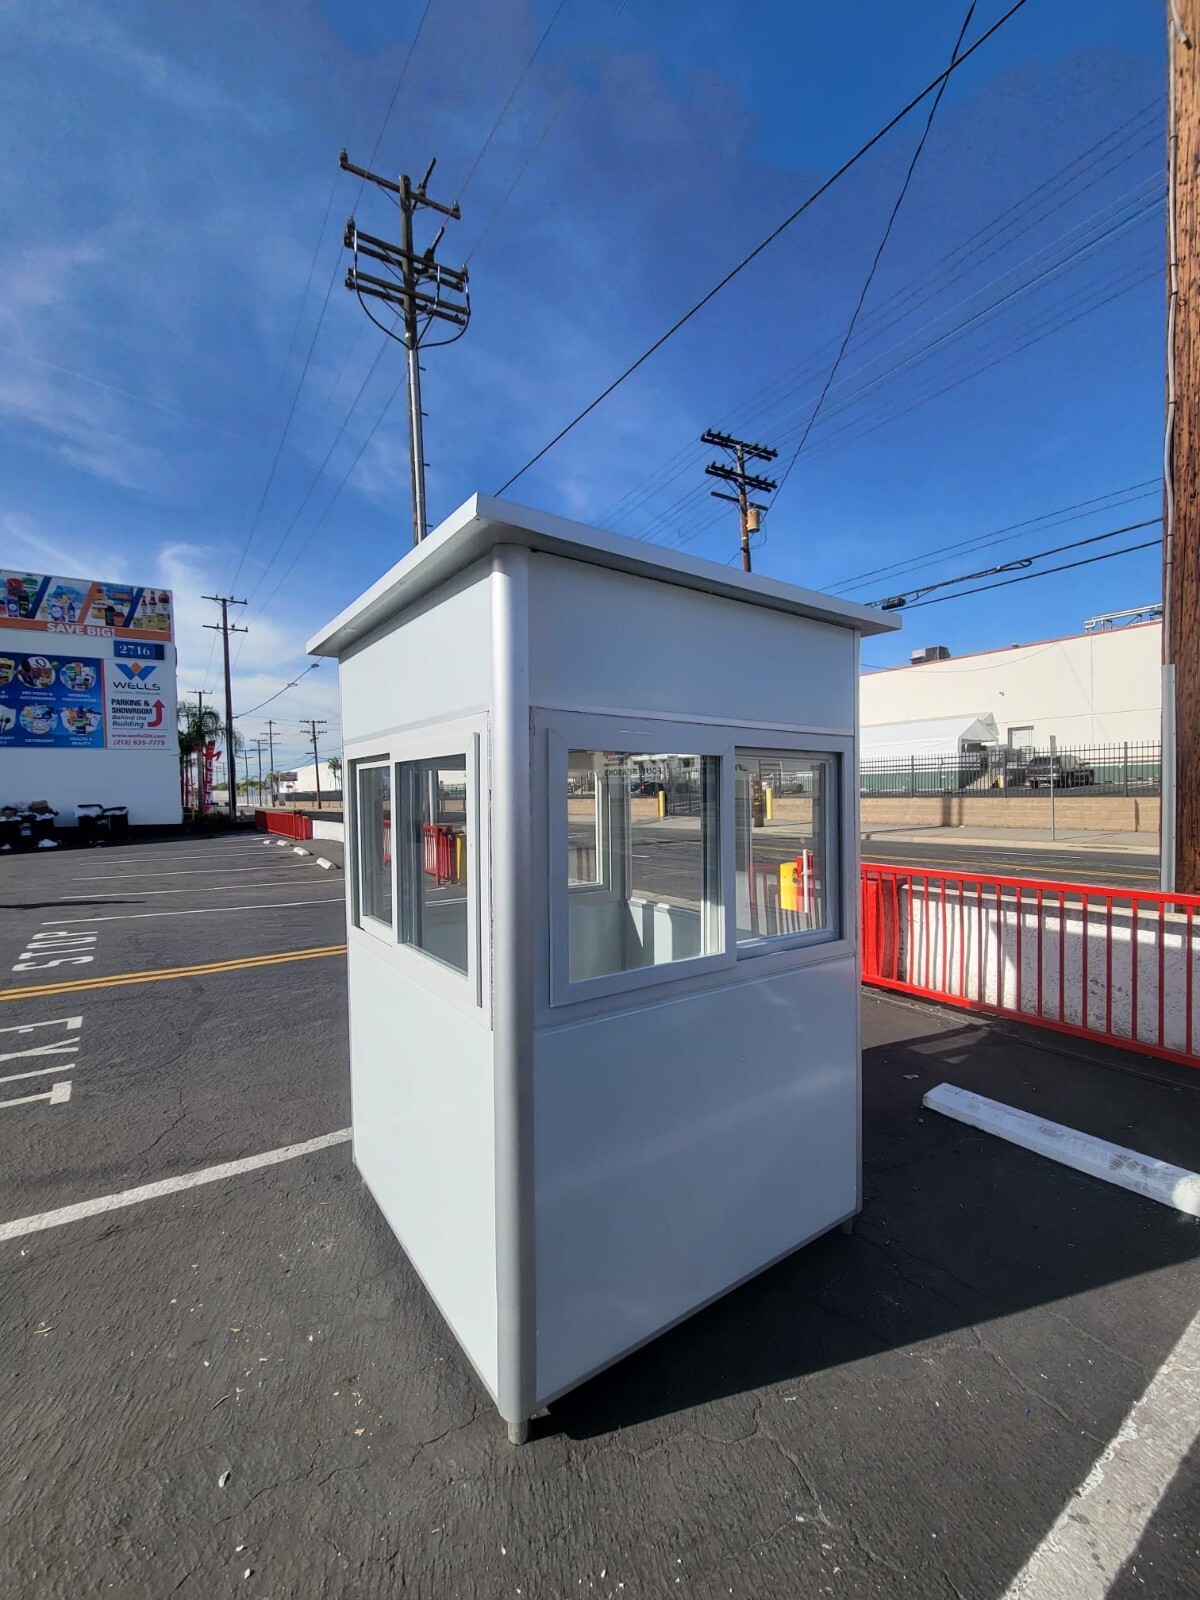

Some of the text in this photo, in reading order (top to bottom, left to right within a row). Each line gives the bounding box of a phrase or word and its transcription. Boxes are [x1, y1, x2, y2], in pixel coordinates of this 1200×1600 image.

[47, 623, 116, 637] SAVE BIG!
[119, 644, 151, 656] 2716
[113, 681, 160, 691] WELLS
[111, 698, 142, 707] PARKING
[112, 720, 145, 729] Building
[12, 931, 98, 971] STOP
